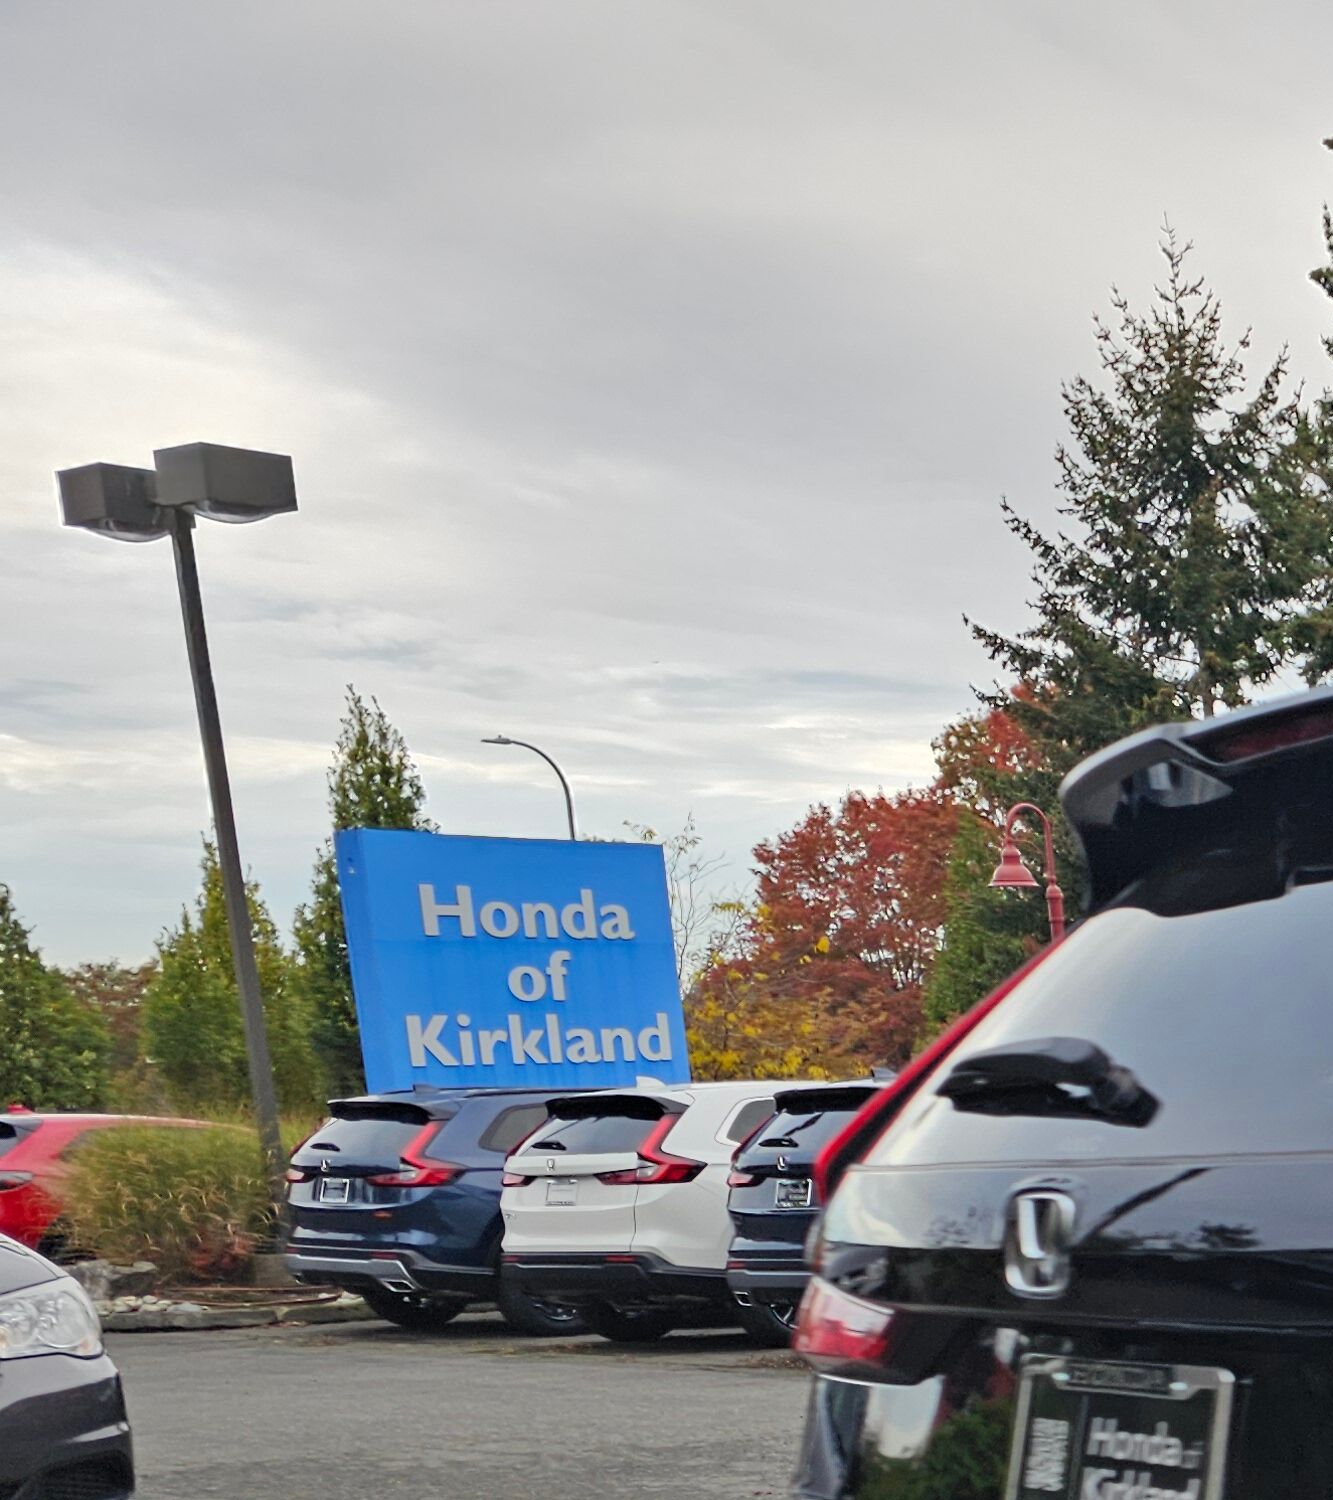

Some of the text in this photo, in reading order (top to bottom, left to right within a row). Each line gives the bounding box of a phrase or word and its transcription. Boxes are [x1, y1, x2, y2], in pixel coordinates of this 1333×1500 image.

[418, 884, 635, 939] Honda
[508, 950, 572, 1001] of
[405, 1012, 673, 1066] Kirkland
[1085, 1417, 1182, 1466] Honda
